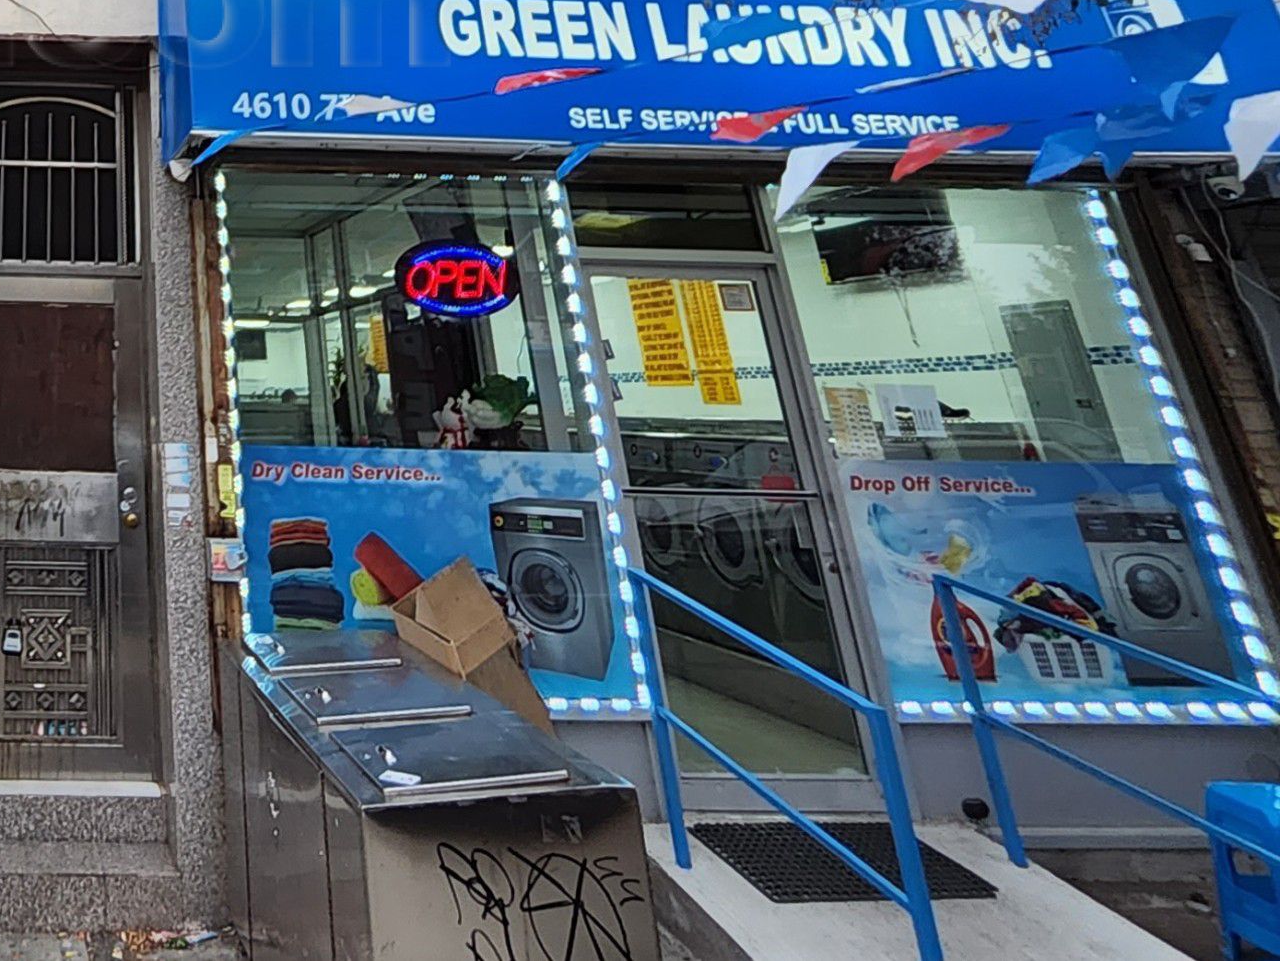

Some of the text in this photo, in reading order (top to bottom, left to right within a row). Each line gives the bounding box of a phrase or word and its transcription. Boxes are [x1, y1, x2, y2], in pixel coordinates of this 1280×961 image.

[924, 8, 1053, 69] INC.
[232, 92, 311, 120] 4610
[569, 107, 633, 130] SELF
[783, 113, 849, 136] FULL
[406, 260, 506, 299] OPEN
[252, 462, 442, 482] Dry Clean Service...
[850, 475, 1032, 495] Drop Off Service...
